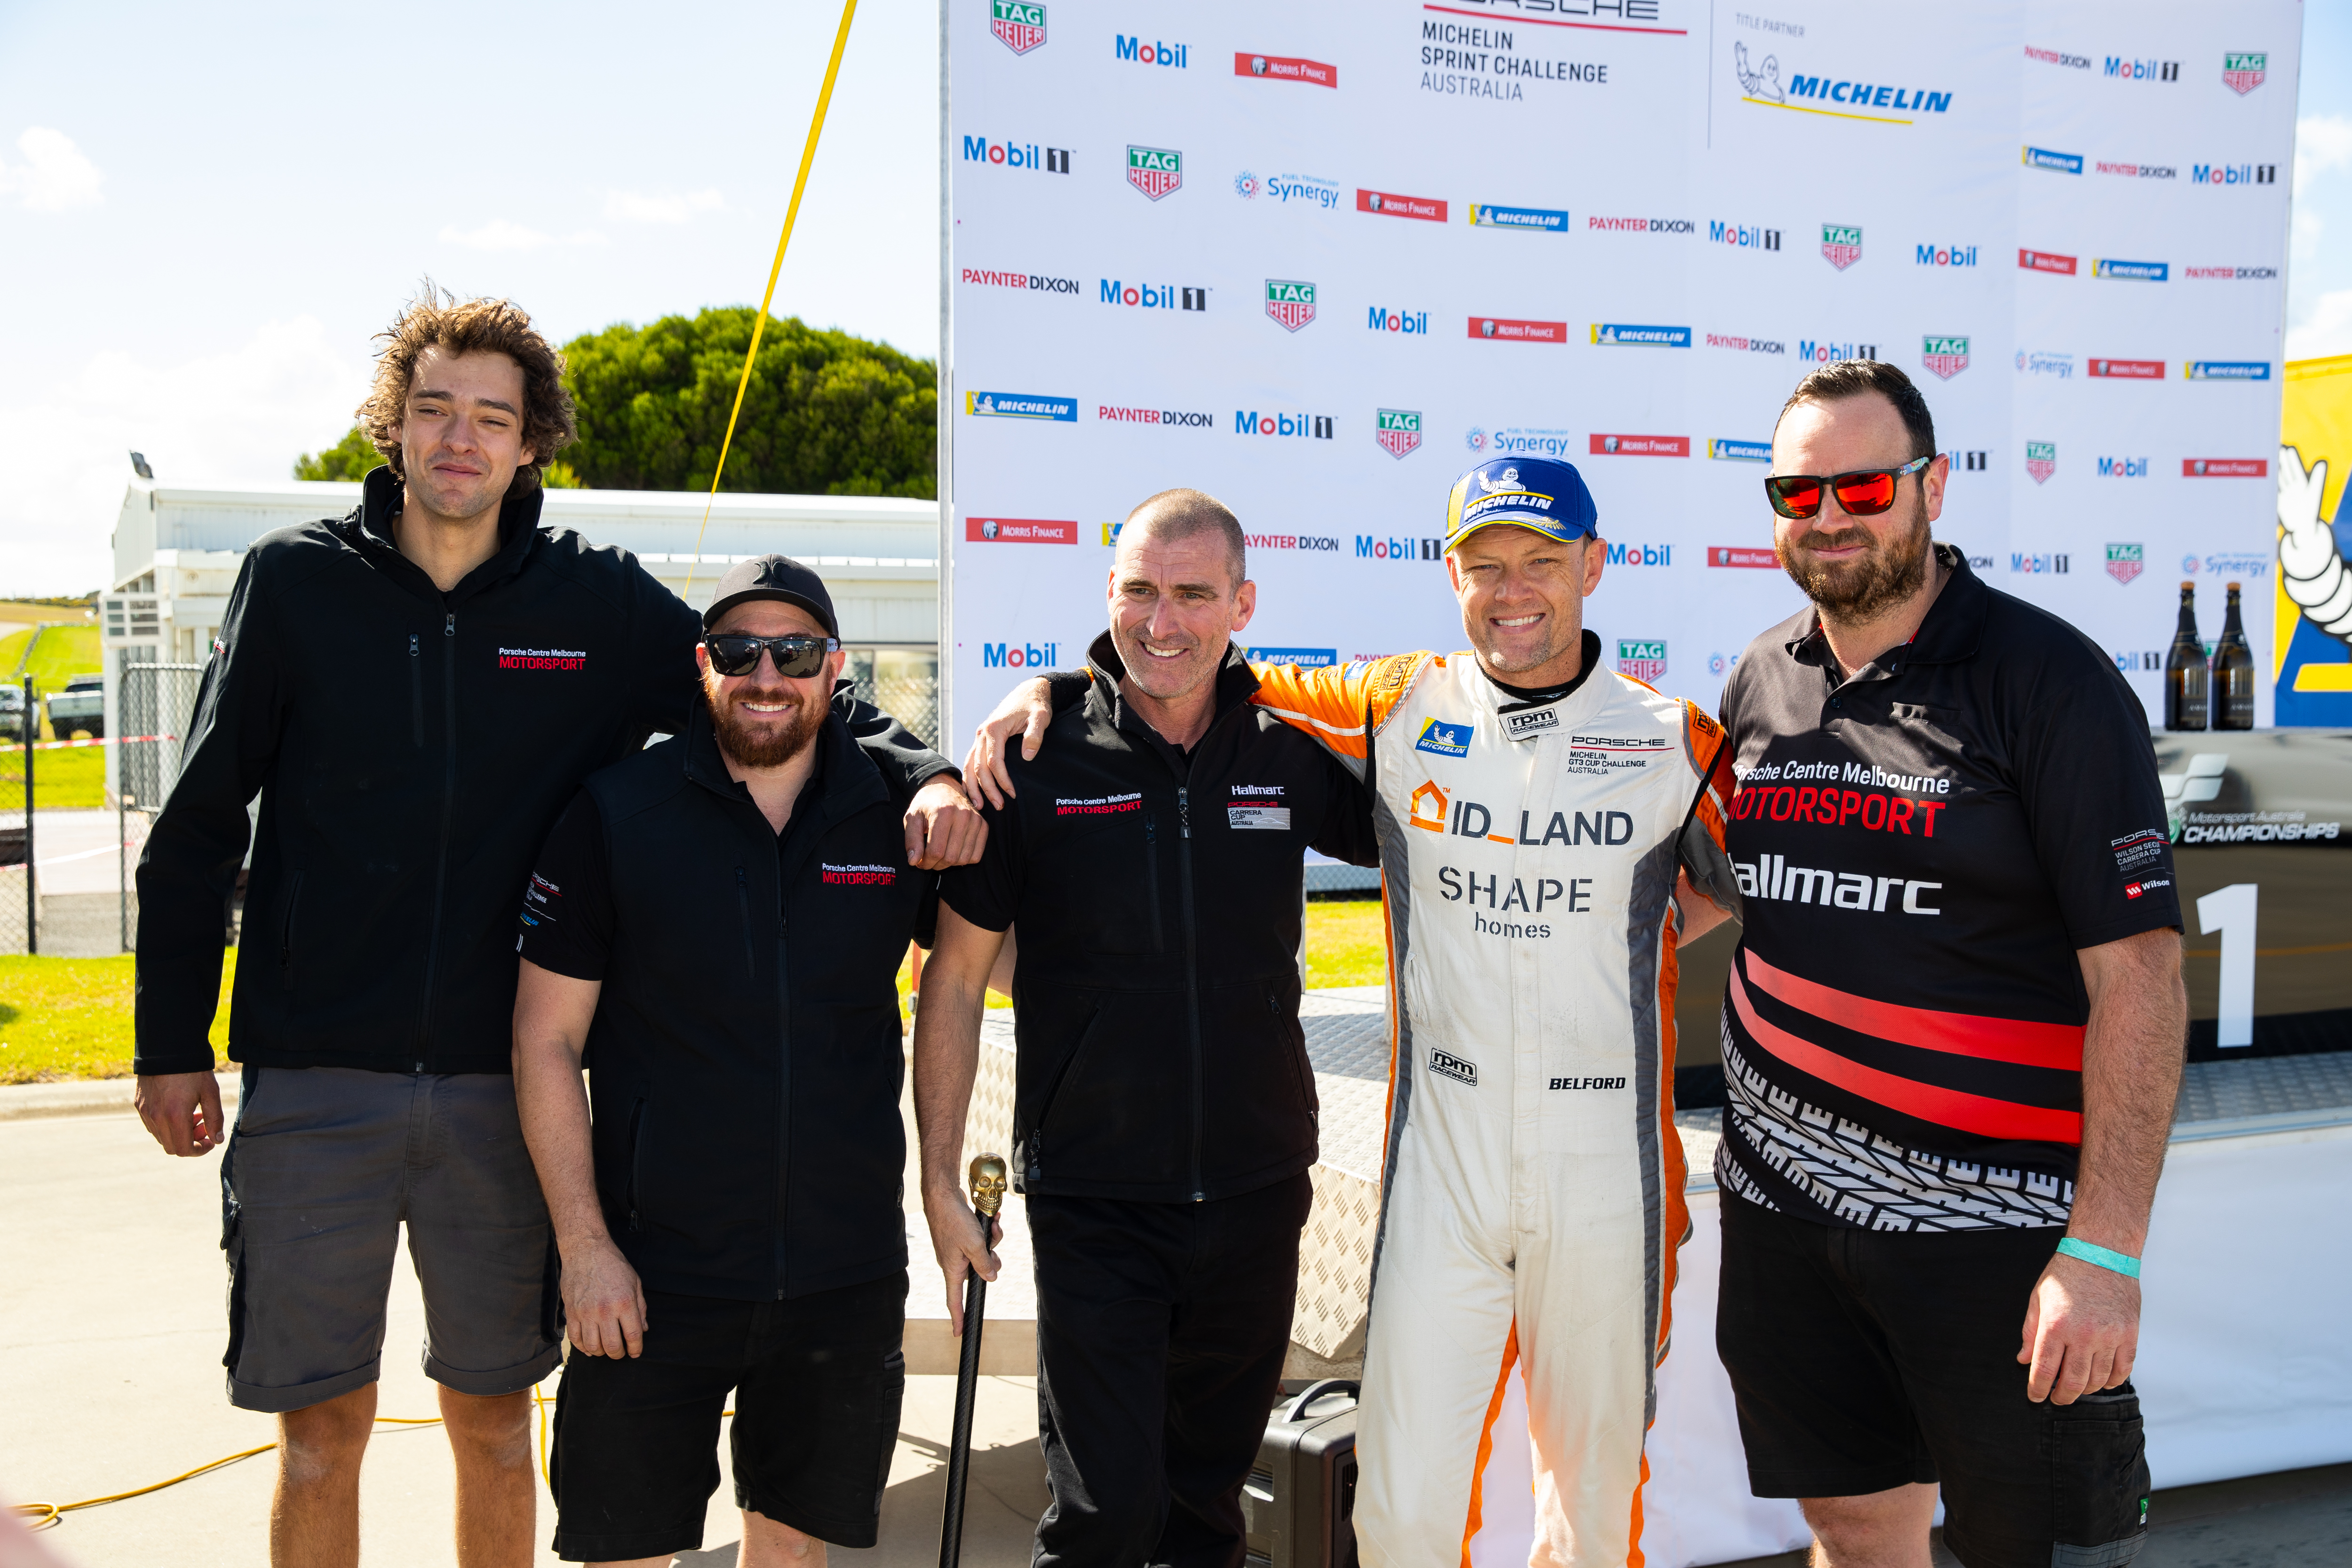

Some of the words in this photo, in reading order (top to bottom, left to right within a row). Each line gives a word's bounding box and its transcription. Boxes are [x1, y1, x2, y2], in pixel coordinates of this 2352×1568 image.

[993, 0, 1041, 25] TAG
[1451, 0, 1659, 21] SCHE
[1736, 12, 1759, 30] TITLE
[1763, 19, 1806, 38] PARTNER
[993, 21, 1043, 52] HEUER
[1422, 21, 1513, 51] MICHELIN
[1116, 34, 1188, 69] Mobil
[1421, 46, 1488, 72] SPRINT
[1494, 51, 1609, 84] CHALLENGE
[2104, 56, 2157, 81] Mobil
[2164, 62, 2178, 81] 1
[2228, 55, 2264, 70] TAG
[1420, 71, 1524, 102] AUSTRALIA
[1789, 74, 1954, 113] MICHELIN
[964, 135, 1039, 170] Mobil
[1049, 148, 1068, 174] 1
[1132, 149, 1177, 170] TAG
[1129, 168, 1179, 199] HEUER
[2192, 164, 2251, 185] Mobil
[2258, 166, 2274, 184] 1
[1268, 176, 1339, 208] Synergy
[1495, 212, 1561, 227] MICHELIN
[1710, 220, 1759, 249] Mobil
[1766, 230, 1780, 251] 1
[1827, 227, 1859, 244] TAG
[1916, 244, 1977, 267] Mobil
[1100, 279, 1174, 309] Mobil
[1184, 287, 1203, 311] 1
[1271, 284, 1313, 302] TAG
[1269, 302, 1314, 330] HEUER
[1368, 306, 1427, 335] Mobil
[1618, 330, 1685, 342] MICHELIN
[1799, 340, 1853, 362] Mobil
[1928, 340, 1966, 355] TAG
[997, 399, 1069, 415] MICHELIN
[1235, 410, 1309, 437] Mobil
[1316, 416, 1332, 439] 1
[1380, 413, 1418, 431] TAG
[1379, 430, 1418, 459] HEUER
[1495, 432, 1568, 456] Synergy
[2028, 443, 2054, 460] TAG
[2098, 456, 2147, 477] Mobil
[1464, 495, 1552, 522] MICHELIN
[1002, 525, 1031, 538] MORRIS
[1033, 525, 1064, 539] FINANCE
[1244, 534, 1296, 549] AYNTER
[1356, 535, 1415, 560] Mobil
[1423, 540, 1440, 561] 1
[1607, 543, 1670, 566] Mobil
[2108, 546, 2142, 560] TAG
[2011, 552, 2051, 574] Mobil
[984, 643, 1056, 668] Mobil
[1265, 654, 1330, 665] MICHELIN
[1622, 643, 1662, 658] TAG
[499, 656, 586, 670] MOTORSPORT
[1390, 657, 1411, 686] rpm
[1510, 709, 1555, 727] rpm
[1512, 719, 1557, 733] RACEWEAR
[1419, 740, 1466, 755] MICHELIN
[1571, 736, 1665, 747] PORSCHE
[1570, 751, 1607, 760] MICHELIN
[1567, 766, 1608, 775] AUSTRALIA
[1734, 762, 1781, 781] Porsche
[1783, 760, 1838, 780] Centre
[1842, 762, 1950, 794] Melbourne
[1107, 792, 1141, 804] Melbourne
[1232, 785, 1285, 795] Hallmarc
[1057, 800, 1142, 815] MOTORSPORT
[2188, 812, 2254, 825] Motorsport
[2257, 810, 2305, 822] Australia
[2111, 828, 2165, 847] PORSE
[2183, 821, 2341, 844] CHAMPIONSHIPS
[2115, 845, 2143, 859] WILSON
[2143, 841, 2160, 850] SECU
[2117, 852, 2149, 866] CARRERA
[822, 863, 846, 871] Porsche
[869, 864, 895, 874] Melbourne
[2120, 856, 2156, 873] AUSTRALIA
[823, 871, 896, 886] MOTORSPORT
[2141, 880, 2169, 890] Wilson
[1438, 866, 1593, 913] SHAPE
[1475, 912, 1551, 939] homes
[2196, 883, 2258, 1049] 1
[1433, 1051, 1474, 1076] rpm
[1430, 1064, 1476, 1085] RACEWEAR
[1548, 1077, 1626, 1090] BELFORD
